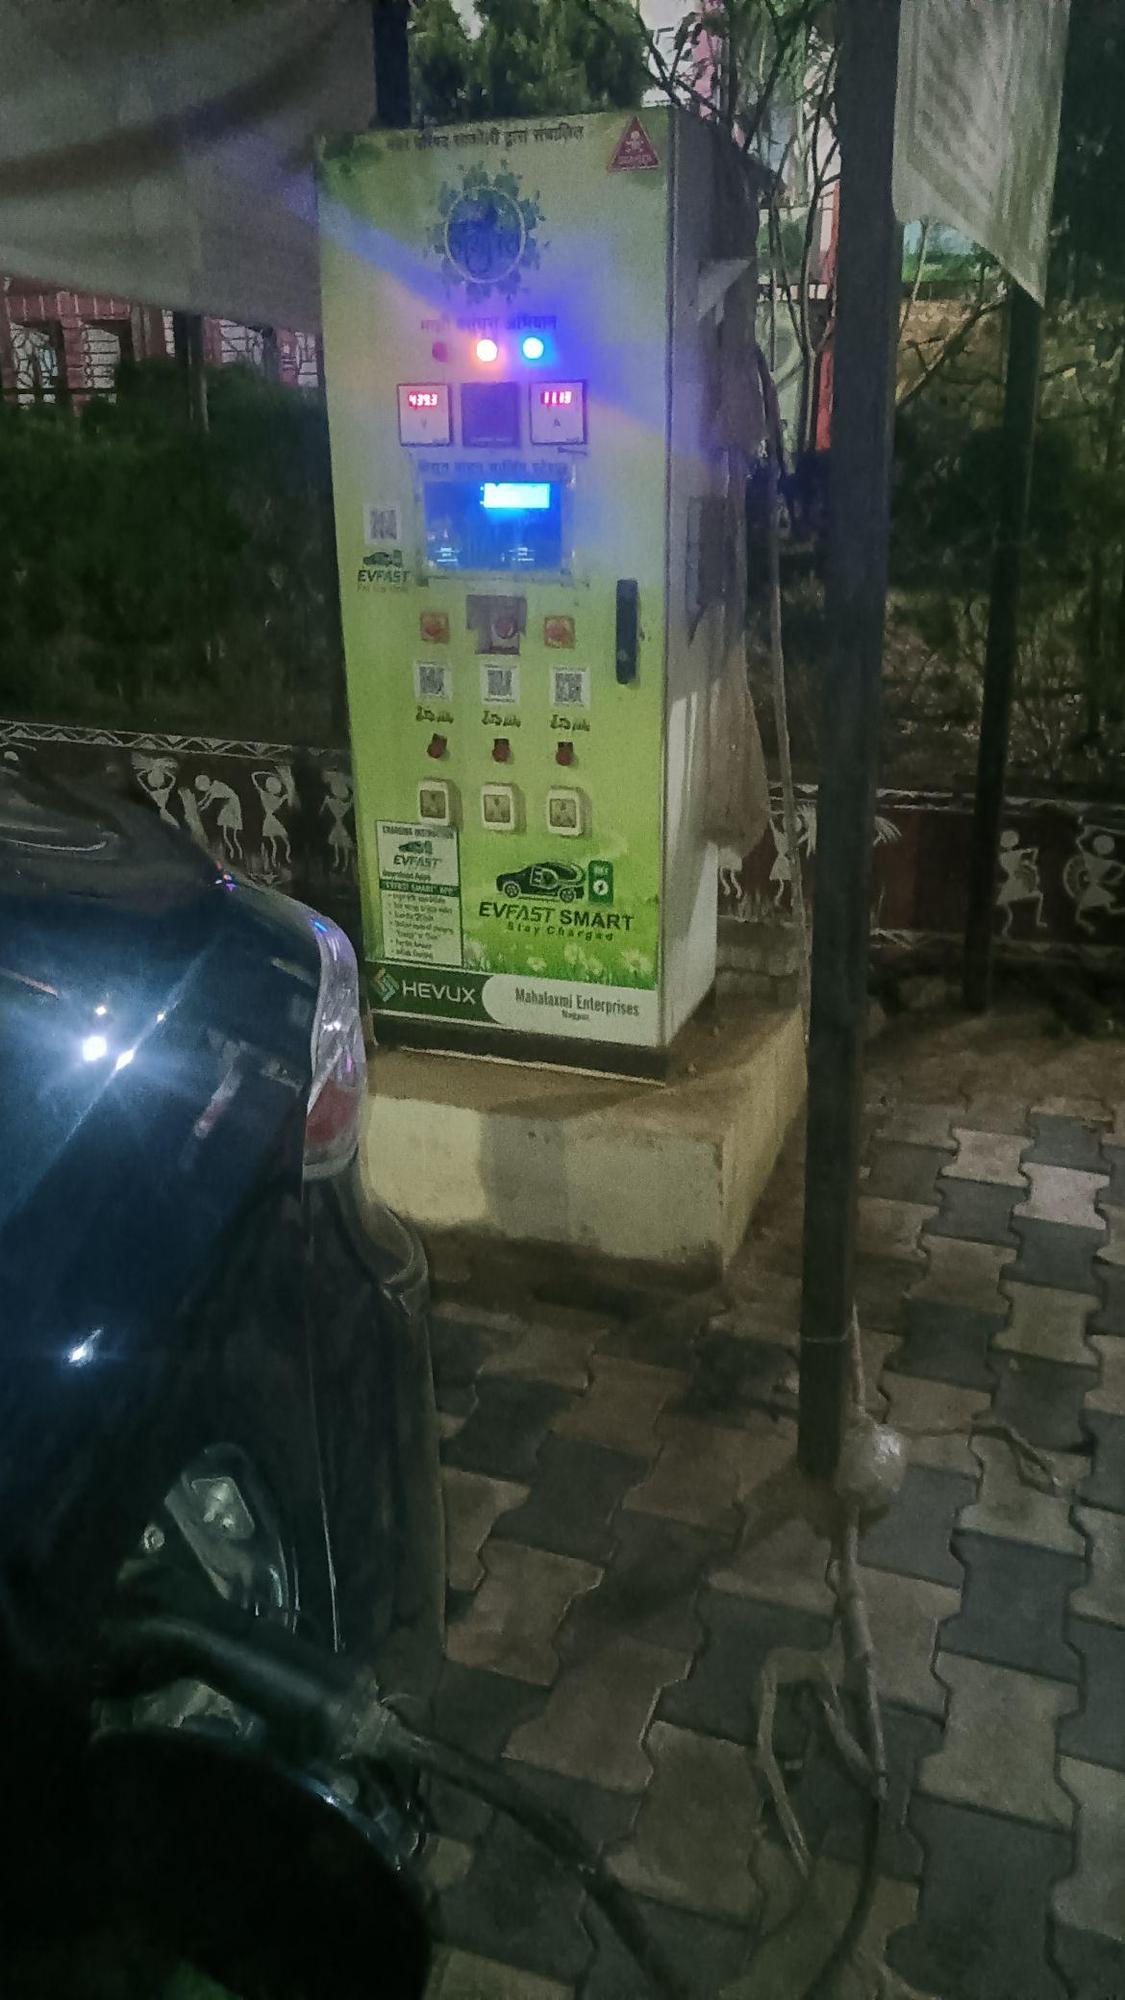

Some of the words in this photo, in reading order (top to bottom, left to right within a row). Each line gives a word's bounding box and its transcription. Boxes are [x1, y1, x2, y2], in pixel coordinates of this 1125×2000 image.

[357, 570, 410, 583] EVFAST
[393, 855, 440, 868] EVFAST
[479, 901, 556, 923] EVFAST
[559, 909, 634, 931] SMART
[508, 921, 541, 937] Stay
[547, 926, 613, 941] Charged
[402, 979, 476, 1005] HEVUX
[515, 987, 572, 1009] Mahalaxmi
[576, 994, 640, 1016] Enterprises
